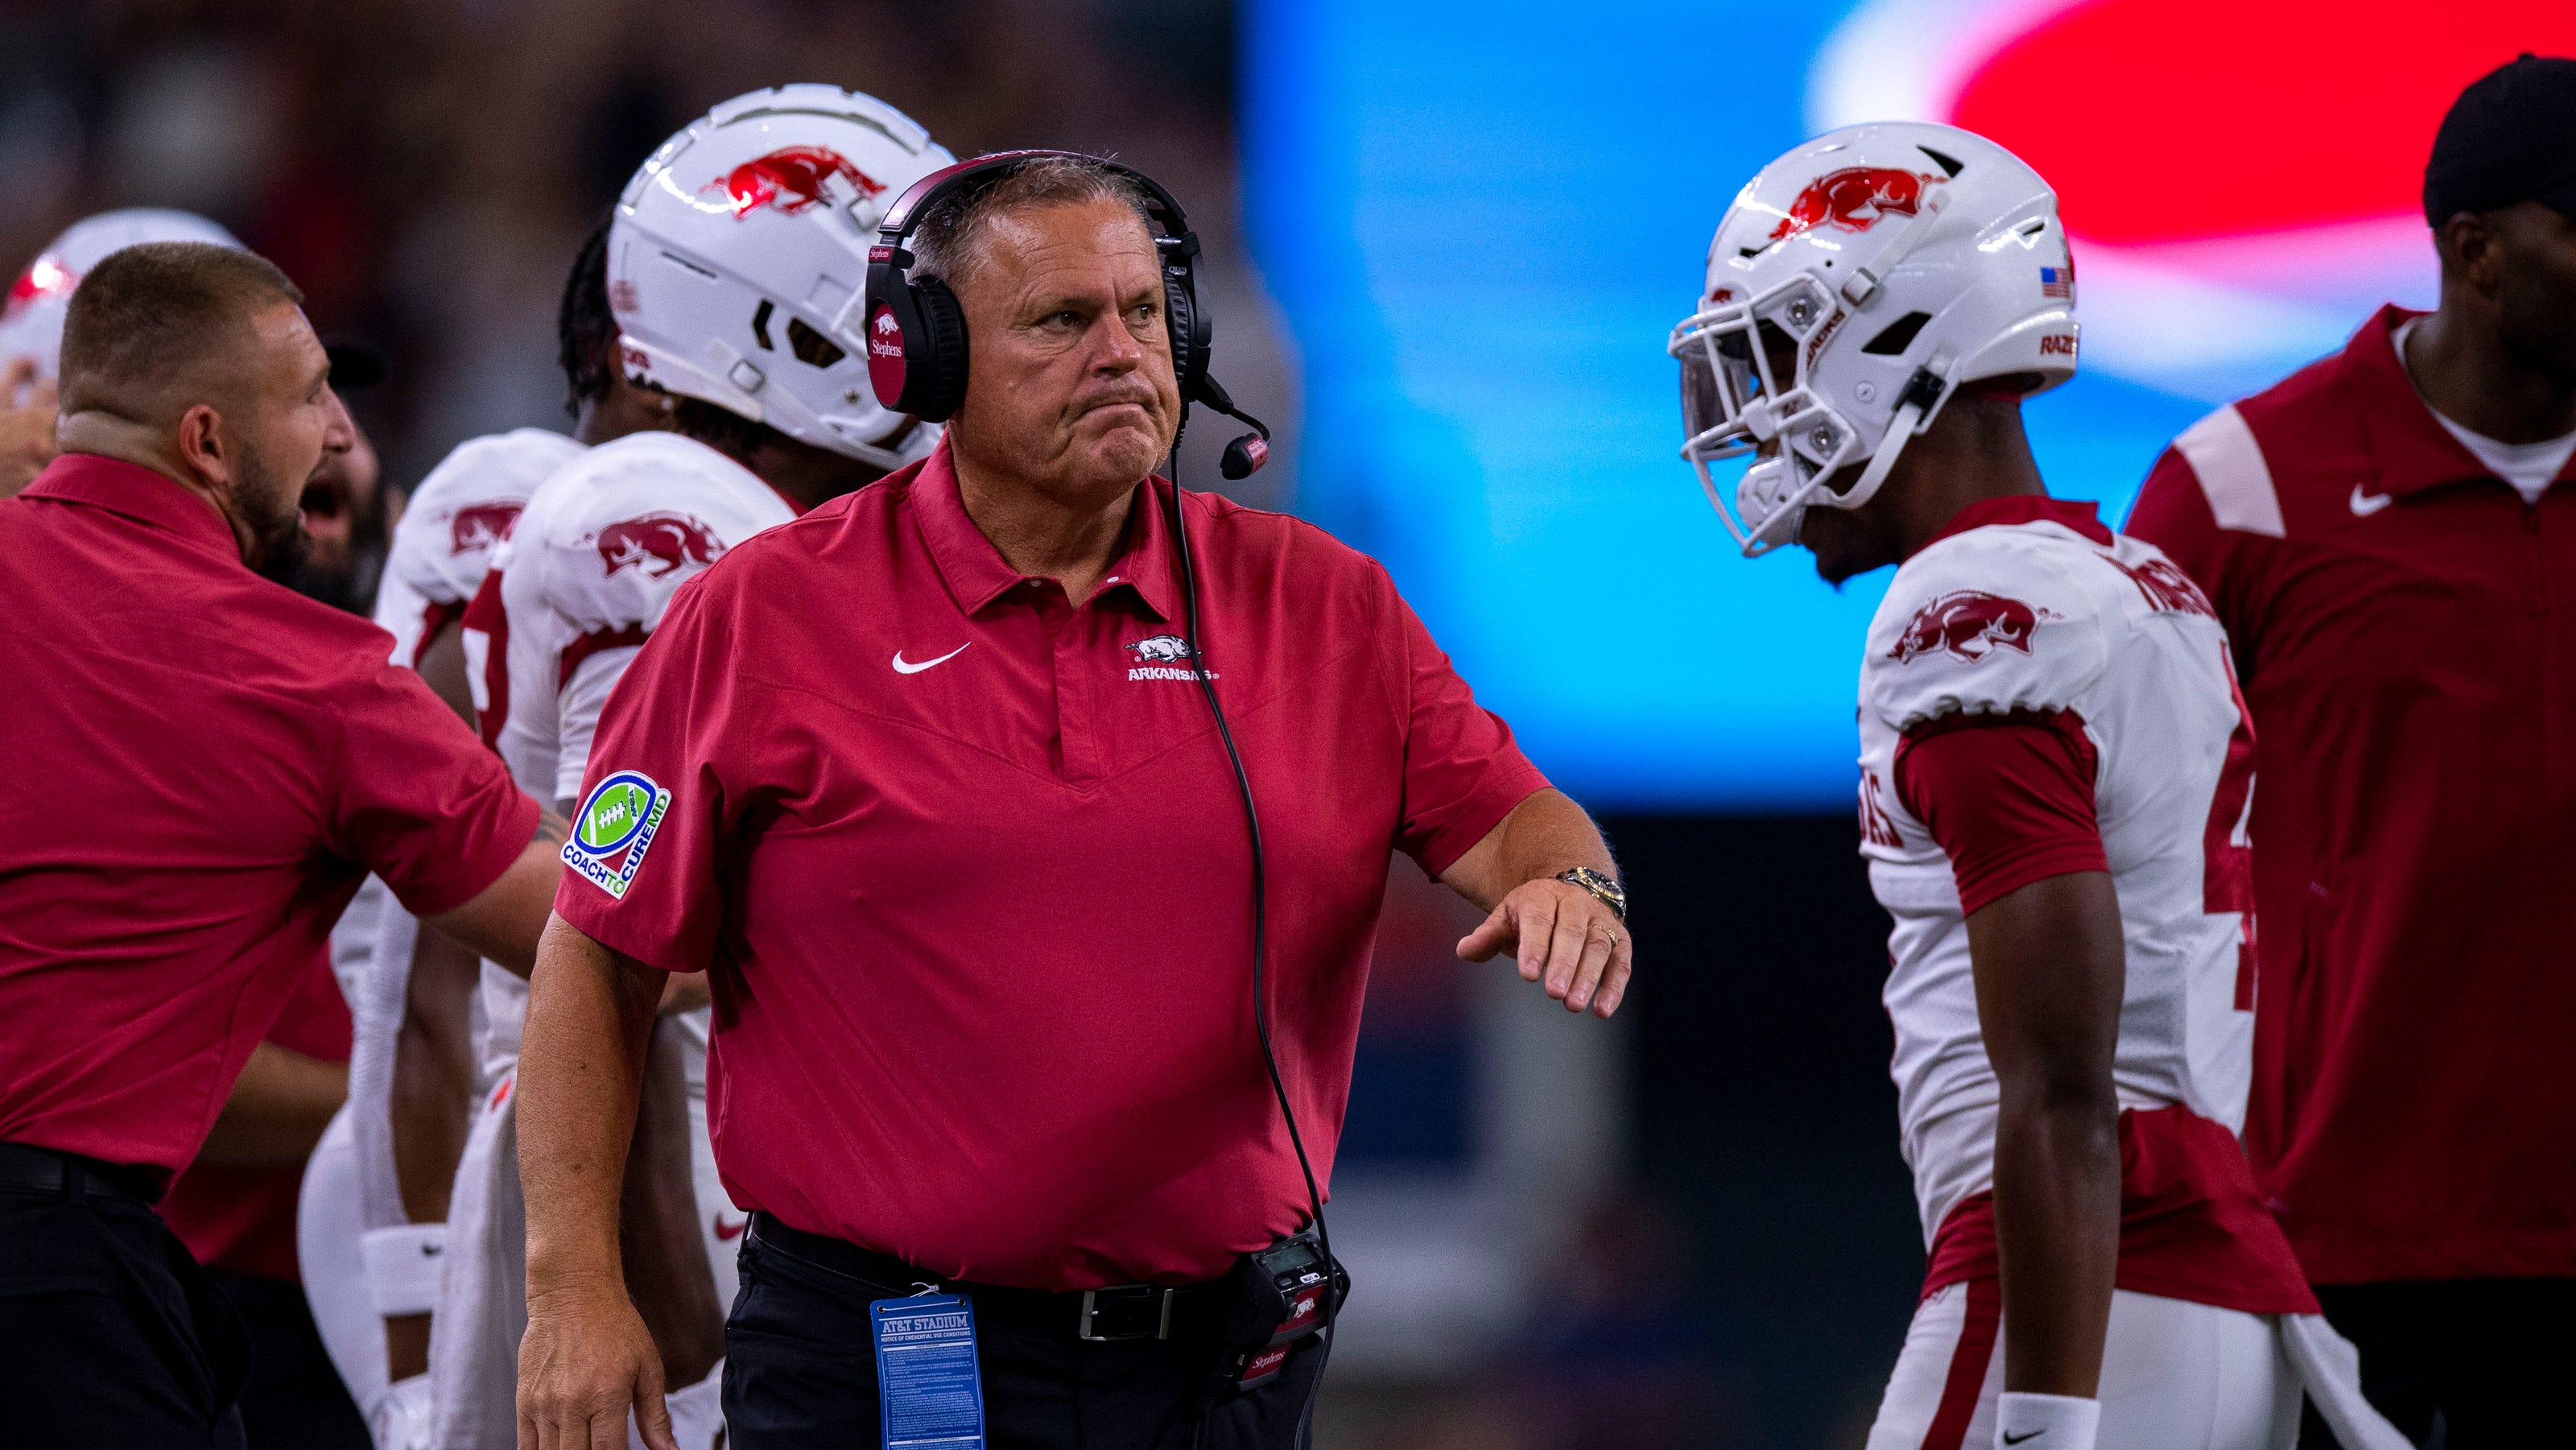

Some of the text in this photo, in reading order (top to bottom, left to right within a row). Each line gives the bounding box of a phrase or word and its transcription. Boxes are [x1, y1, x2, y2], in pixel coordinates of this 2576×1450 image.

[869, 248, 890, 259] Stephens
[873, 339, 902, 357] Stephens
[883, 1315, 968, 1333] AT&T STADIUM
[943, 1330, 971, 1338] CONDITIONS
